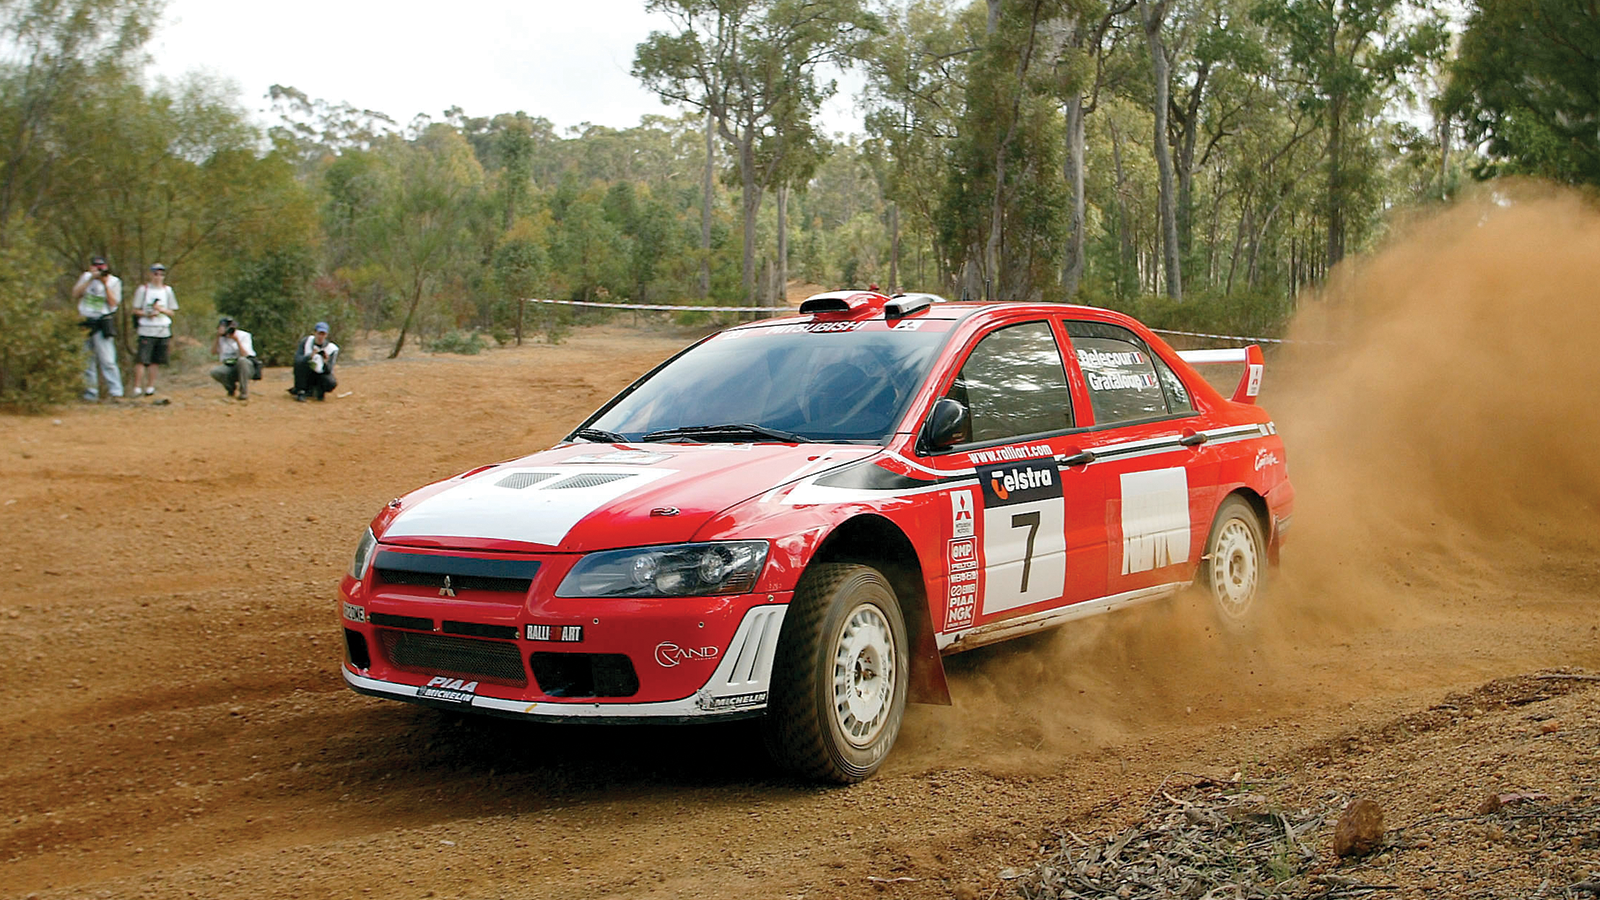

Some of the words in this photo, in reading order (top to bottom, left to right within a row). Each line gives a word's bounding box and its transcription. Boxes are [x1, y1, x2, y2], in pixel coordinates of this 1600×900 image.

[967, 444, 1053, 464] www.ralliart.com
[991, 467, 1053, 499] Telstra
[1011, 510, 1041, 593] 7
[950, 595, 974, 608] PIAA
[948, 606, 973, 623] NGK
[427, 676, 479, 692] PIAA
[425, 689, 474, 702] MICHELIN
[714, 693, 766, 707] MICHELIN
